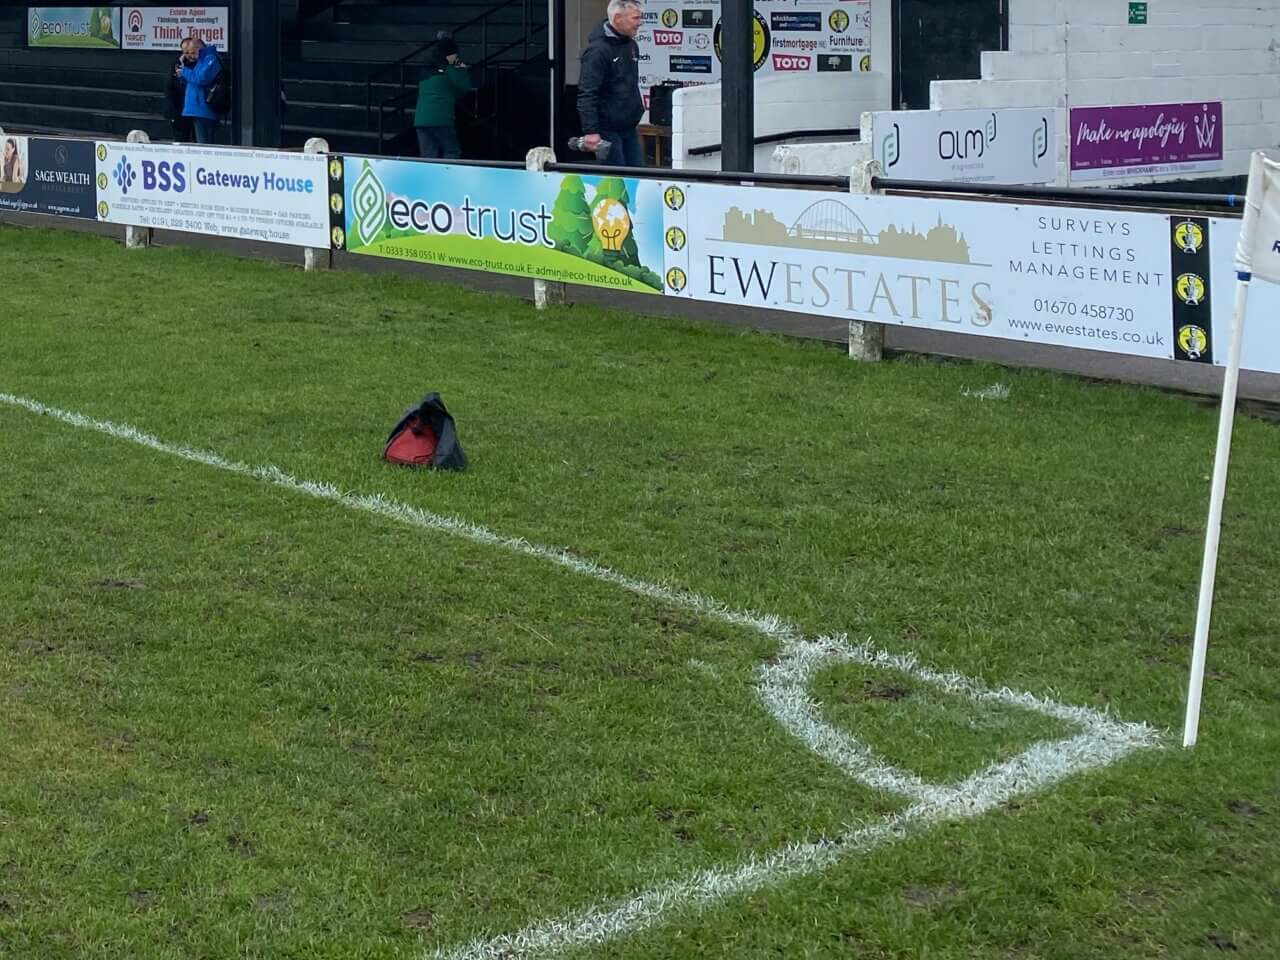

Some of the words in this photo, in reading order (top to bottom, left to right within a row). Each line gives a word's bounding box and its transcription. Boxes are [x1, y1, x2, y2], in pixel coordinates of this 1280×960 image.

[41, 22, 62, 35] eco
[152, 25, 183, 40] Think
[186, 25, 225, 42] Target
[655, 31, 682, 44] TOTO
[772, 36, 818, 51] firstmortgage
[829, 35, 864, 47] Furniture
[773, 56, 809, 69] TOTO
[1076, 118, 1115, 147] Make
[1115, 126, 1131, 143] no
[1132, 112, 1188, 152] apologies
[34, 169, 55, 183] SAGE
[54, 170, 91, 186] WEALTH
[141, 159, 187, 193] BSS
[196, 167, 260, 194] Gateway
[263, 171, 314, 194] House
[389, 197, 455, 233] eco
[461, 197, 555, 246] trust
[1038, 216, 1131, 236] SURVEYS
[386, 246, 404, 257] 0333
[405, 248, 418, 258] 358
[418, 250, 437, 261] 0551
[448, 254, 526, 274] www.eco-trust.co.uk
[1032, 240, 1136, 262] LETTINGS
[1009, 259, 1165, 287] MANAGEMENT
[1033, 298, 1077, 316] 01670
[1080, 303, 1134, 323] 458730
[1008, 318, 1164, 347] www.ewestates.co.uk
